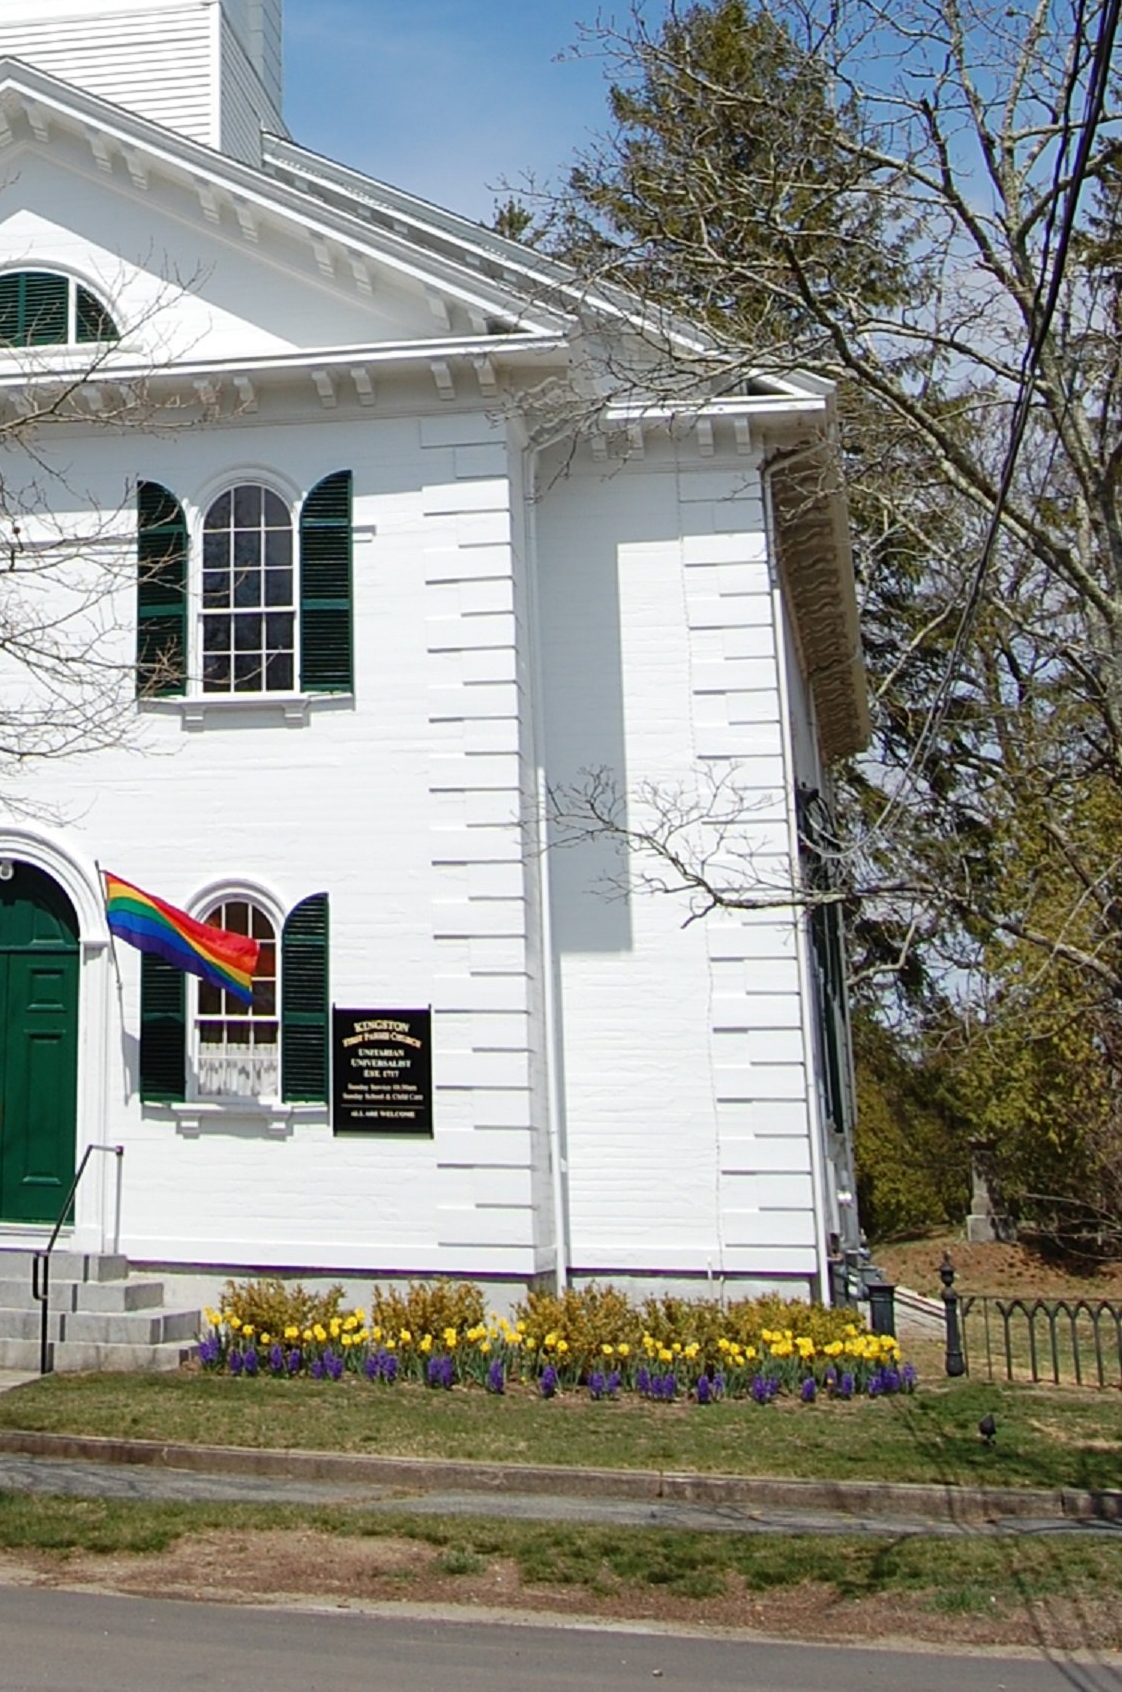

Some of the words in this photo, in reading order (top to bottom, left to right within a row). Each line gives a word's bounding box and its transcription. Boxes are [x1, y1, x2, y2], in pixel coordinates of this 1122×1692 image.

[353, 1019, 410, 1033] KINGSTON
[358, 1048, 405, 1057] UNITARIAN
[350, 1058, 411, 1068] UNIVERSALIST
[379, 1110, 416, 1119] WELCOME
